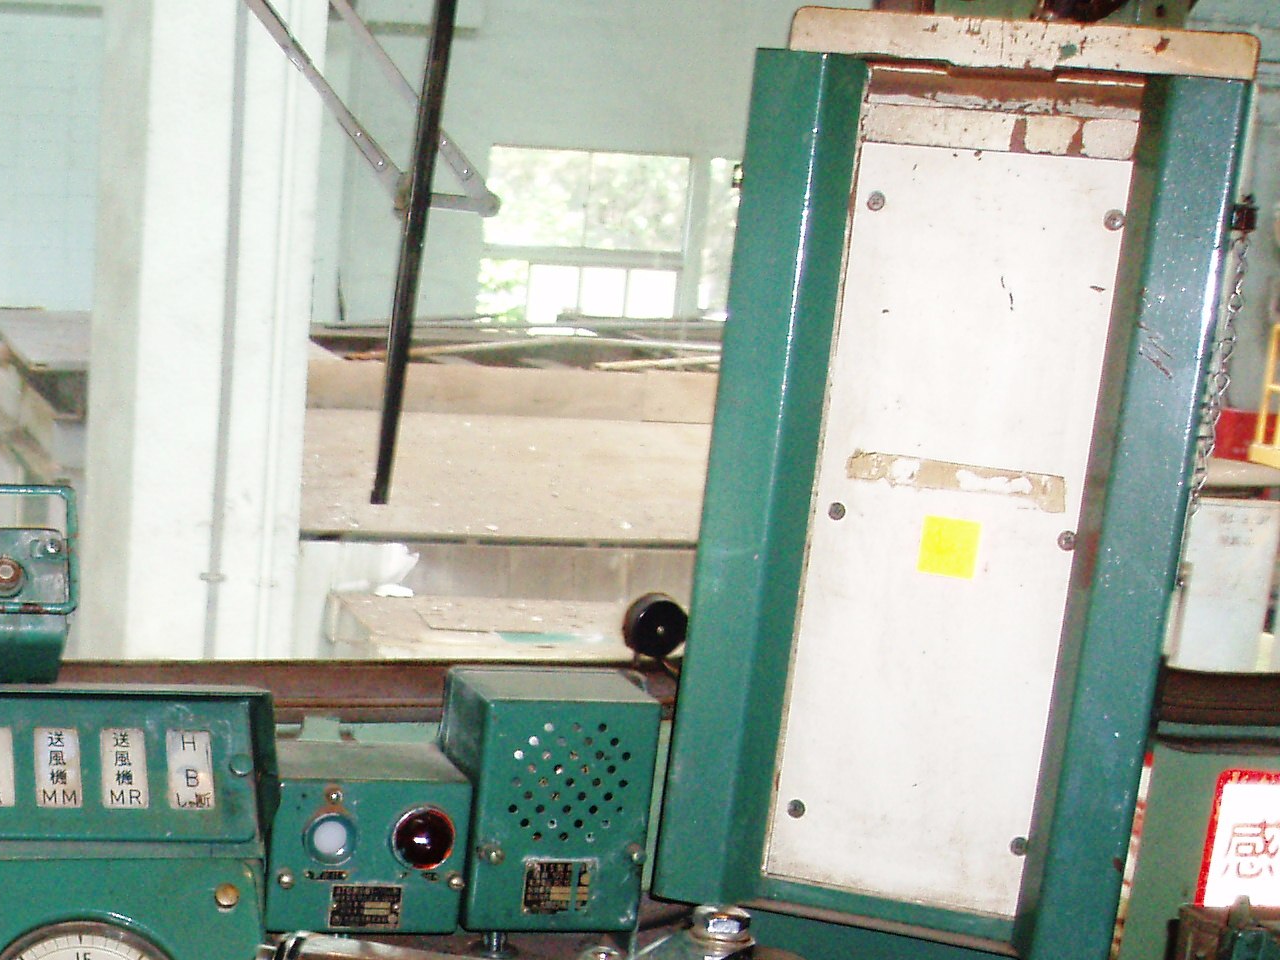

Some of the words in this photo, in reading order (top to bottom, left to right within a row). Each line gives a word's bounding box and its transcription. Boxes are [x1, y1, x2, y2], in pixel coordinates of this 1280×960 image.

[48, 731, 67, 785] 送風機
[113, 732, 133, 786] 送風機
[42, 789, 77, 805] MM
[110, 789, 141, 805] MR
